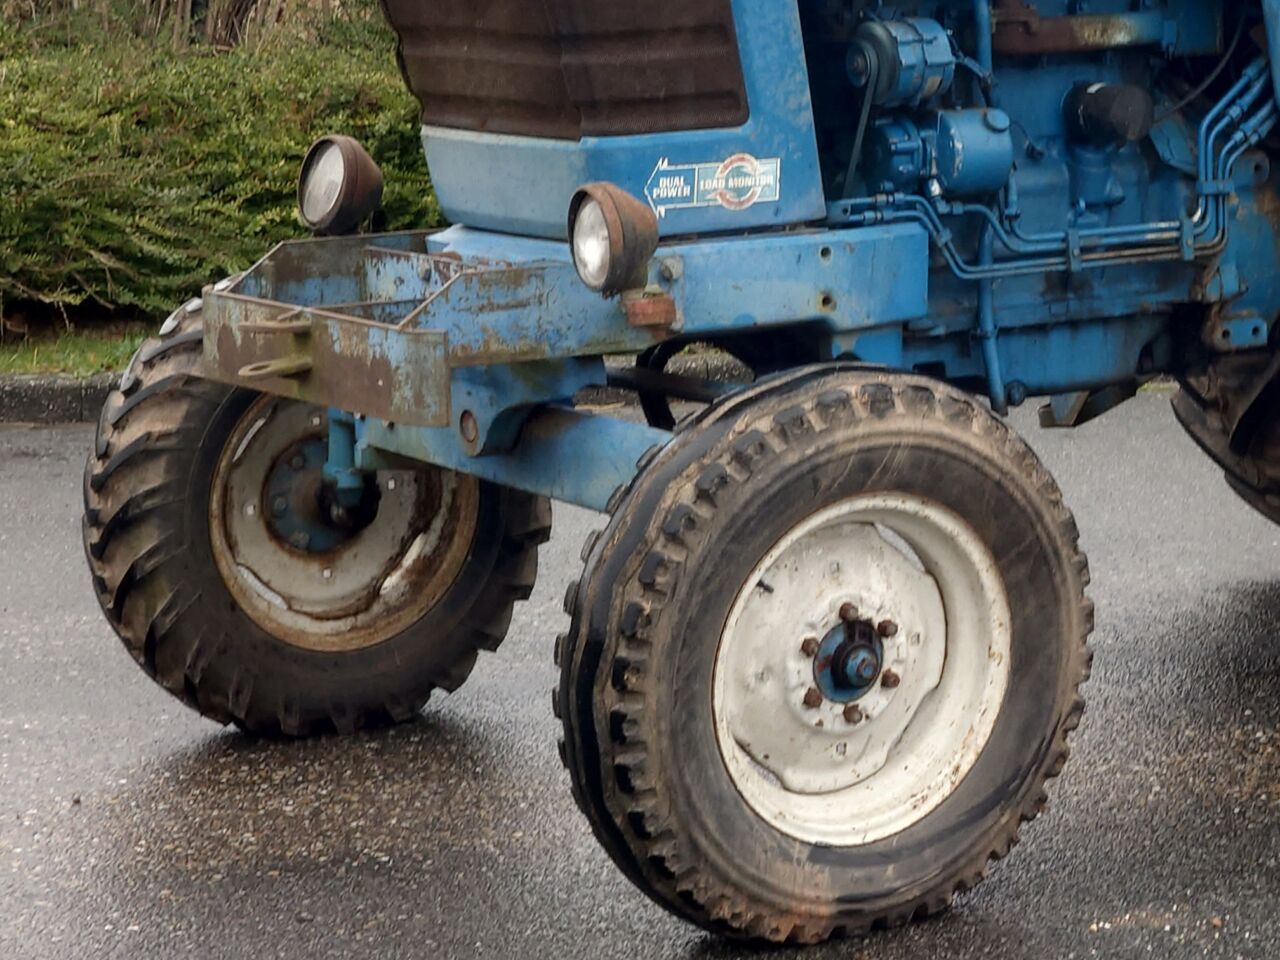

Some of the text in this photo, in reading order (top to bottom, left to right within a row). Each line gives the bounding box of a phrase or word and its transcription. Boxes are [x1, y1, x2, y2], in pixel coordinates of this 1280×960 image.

[659, 176, 685, 187] DUAL
[700, 175, 774, 190] LOAD MONITOR
[653, 186, 691, 198] POWER
